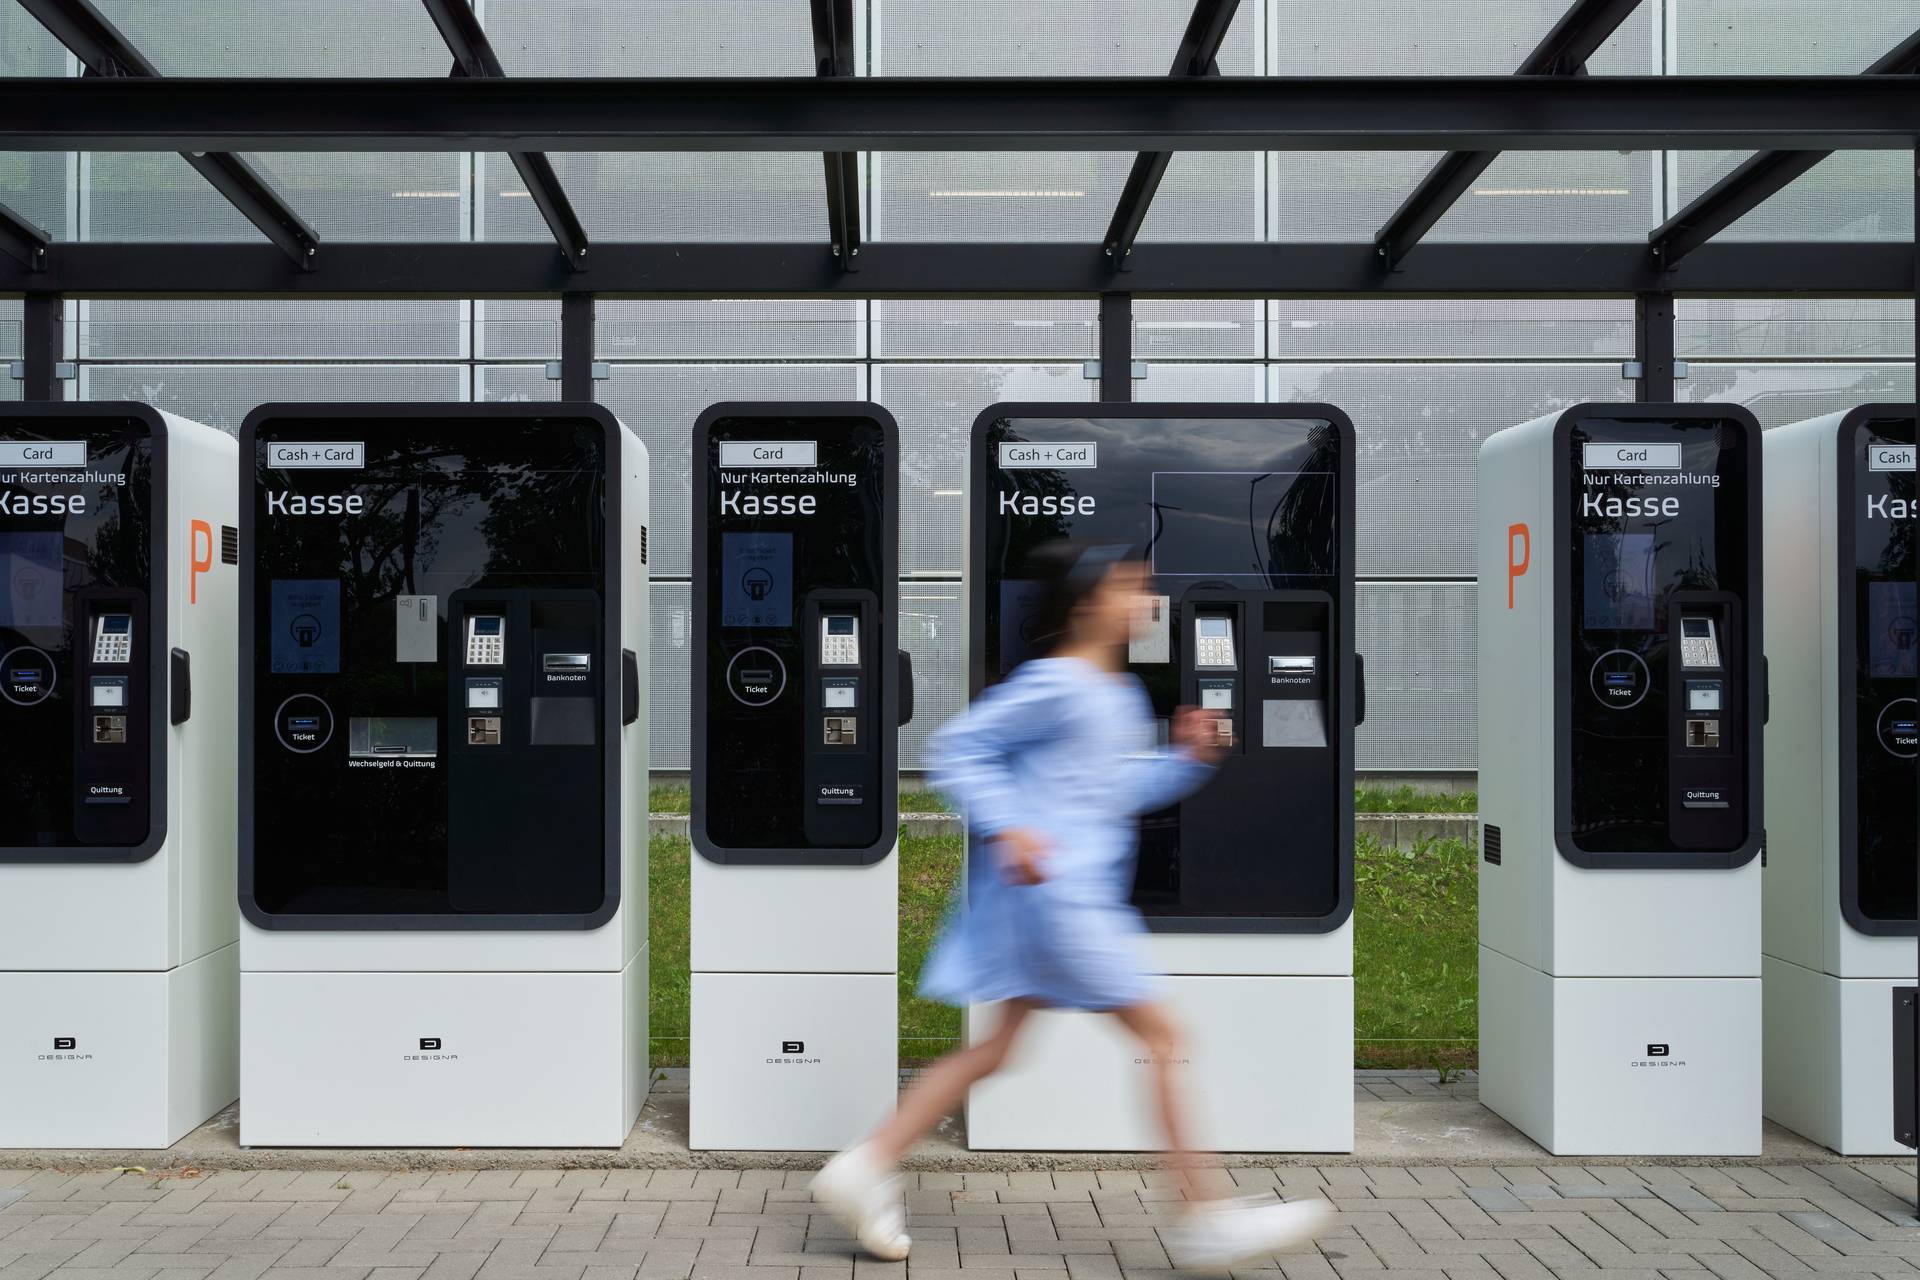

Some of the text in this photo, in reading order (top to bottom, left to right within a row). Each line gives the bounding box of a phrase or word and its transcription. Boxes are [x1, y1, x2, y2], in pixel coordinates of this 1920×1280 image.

[24, 448, 53, 460] Card
[278, 448, 354, 460] Cash + Card
[753, 448, 783, 460] Card
[1009, 449, 1086, 460] Cash + Card
[1616, 450, 1647, 462] Card
[1880, 452, 1910, 464] Cash
[0, 471, 126, 486] ur Kartenzahlung
[721, 471, 857, 486] Nur Kartenzahlung
[1583, 472, 1720, 488] Nur Kartenzahlung
[268, 491, 363, 515] Kasse
[721, 491, 816, 515] Kasse
[1000, 491, 1096, 515] Kasse
[1584, 493, 1680, 517] Kasse
[191, 519, 213, 605] P
[1508, 523, 1530, 609] P
[403, 760, 436, 768] Quittung
[822, 788, 854, 796] Quittung
[1687, 792, 1720, 800] Quittung
